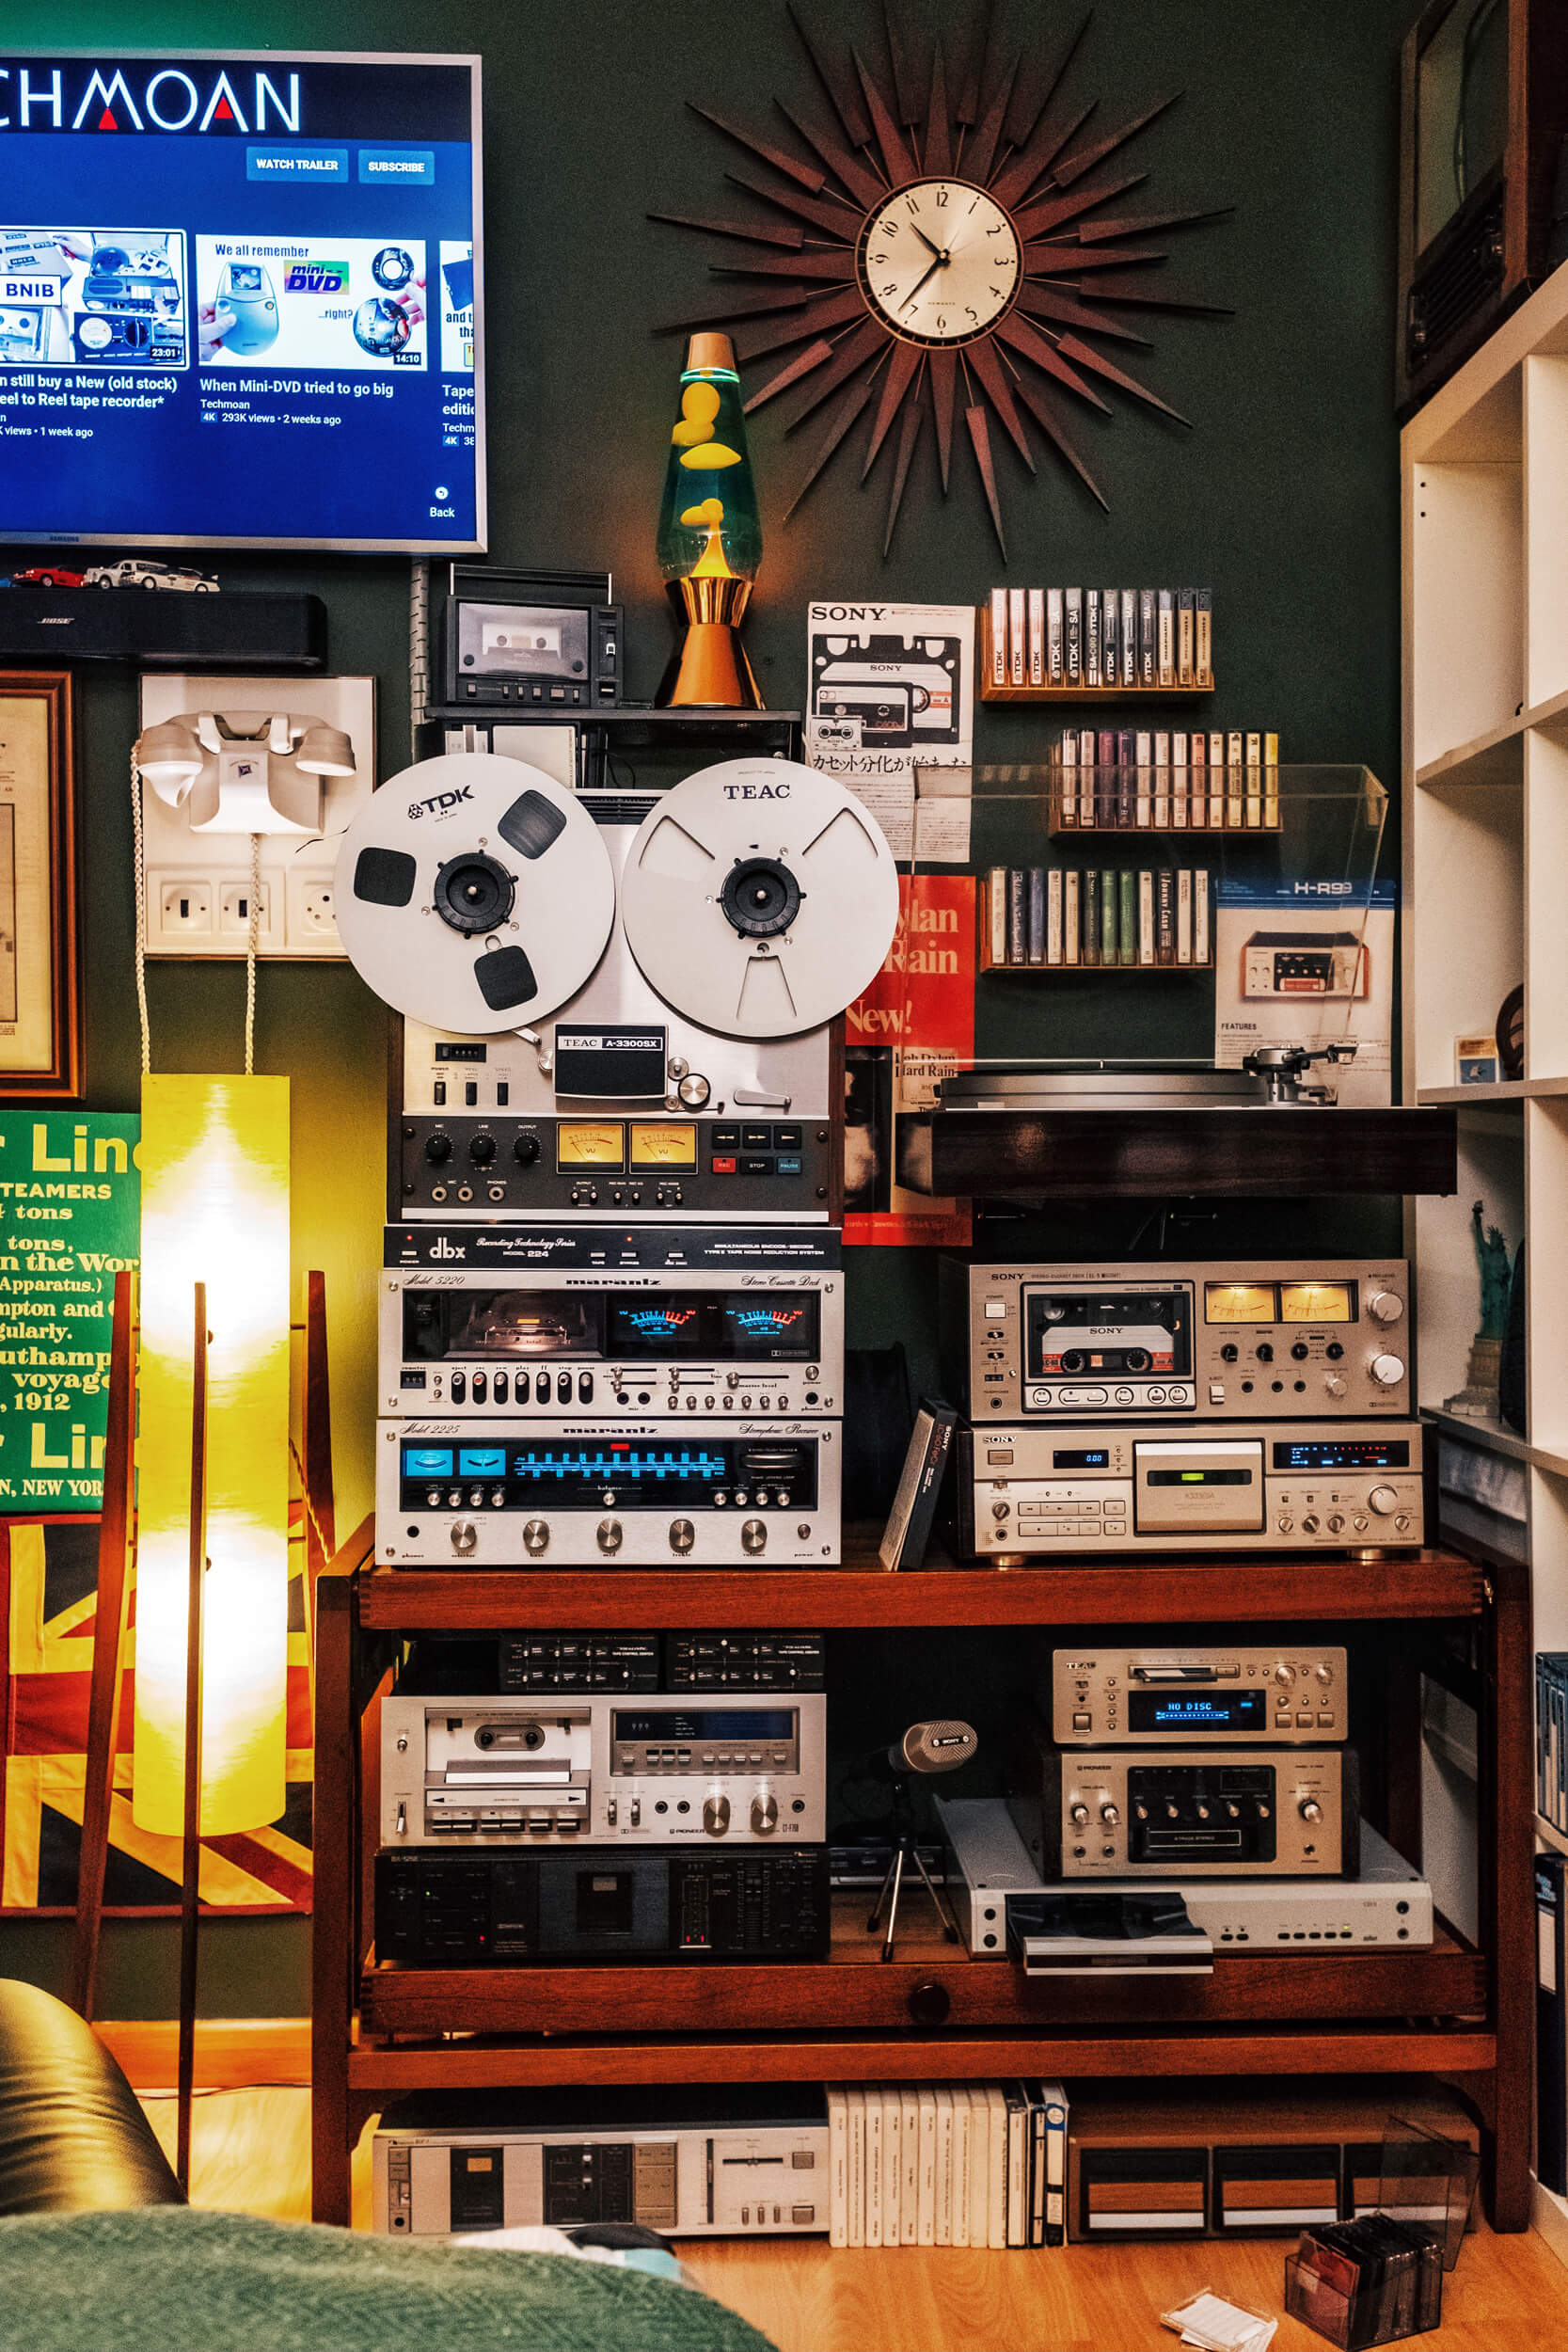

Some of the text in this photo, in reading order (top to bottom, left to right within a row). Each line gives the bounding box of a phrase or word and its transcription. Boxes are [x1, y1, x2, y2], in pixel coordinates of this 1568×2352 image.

[0, 69, 301, 132] HMOAN
[256, 158, 339, 171] WATCH TRAILER
[368, 161, 425, 173] SUBSCRIBE
[936, 191, 949, 207] 12
[881, 220, 899, 238] 10
[985, 224, 1002, 237] 2
[215, 244, 309, 258] We all remember
[875, 253, 890, 264] 9
[993, 257, 1009, 265] 3
[6, 283, 55, 297] BNIB
[288, 275, 342, 292] DVD
[882, 283, 897, 297] 8
[989, 285, 1002, 297] 4
[446, 312, 466, 324] and
[909, 304, 919, 317] 7
[964, 306, 978, 322] 5
[936, 314, 947, 329] 6
[151, 348, 177, 358] 23:01
[395, 354, 420, 363] 14:10
[9, 374, 35, 387] still
[38, 374, 62, 390] buy
[64, 378, 72, 388] a
[75, 375, 104, 389] New
[108, 375, 134, 391] (old
[135, 377, 178, 393] stock)
[199, 378, 394, 398] When Mini-DVD tried to go big
[442, 384, 474, 400] Tape
[0, 391, 19, 405] eel
[21, 392, 36, 405] to
[39, 392, 67, 406] Reel
[70, 395, 100, 409] tape
[200, 399, 250, 410] Techmoan
[202, 412, 341, 427] 4K 293K views 2 weeks ago
[5, 425, 94, 439] views 1 week ago
[444, 437, 457, 445] 4K
[429, 506, 455, 518] Back
[812, 606, 886, 621] SONY
[1052, 643, 1061, 671] TDK
[1069, 643, 1079, 671] TDK
[1106, 650, 1115, 675] TDK
[1125, 650, 1133, 675] TDK
[1144, 651, 1152, 675] TDK
[420, 785, 476, 814] TDK
[723, 784, 791, 800] TEAC
[1161, 878, 1172, 930] JOHNNY CASH
[894, 899, 959, 939] ylan
[880, 939, 959, 974] Rain
[845, 999, 912, 1035] New!
[1221, 1023, 1258, 1031] FEATURES
[562, 1039, 658, 1049] TEAC A-3300SX
[928, 1065, 956, 1077] Rain
[0, 1183, 112, 1200] TEAMERS
[15, 1204, 73, 1220] tons
[8, 1235, 74, 1253] tons,
[429, 1236, 467, 1260] dbx
[476, 1237, 577, 1250] Recording Technology Series
[0, 1251, 140, 1273] n the Wor
[403, 1273, 467, 1286] Model 5220
[564, 1276, 662, 1286] marantz
[740, 1275, 820, 1287] Stereo Cassette Deck
[62, 1301, 104, 1318] and
[0, 1346, 112, 1372] uthamp
[14, 1392, 71, 1411] 1912
[399, 1422, 461, 1435] Model 2225
[562, 1426, 659, 1435] marantz
[941, 1425, 952, 1452] SONY
[983, 1436, 1018, 1444] SONY
[1085, 1454, 1102, 1463] 0.00
[22, 1479, 64, 1496] NEW
[66, 1479, 104, 1497] YOR
[1167, 1702, 1212, 1710] NO DISC
